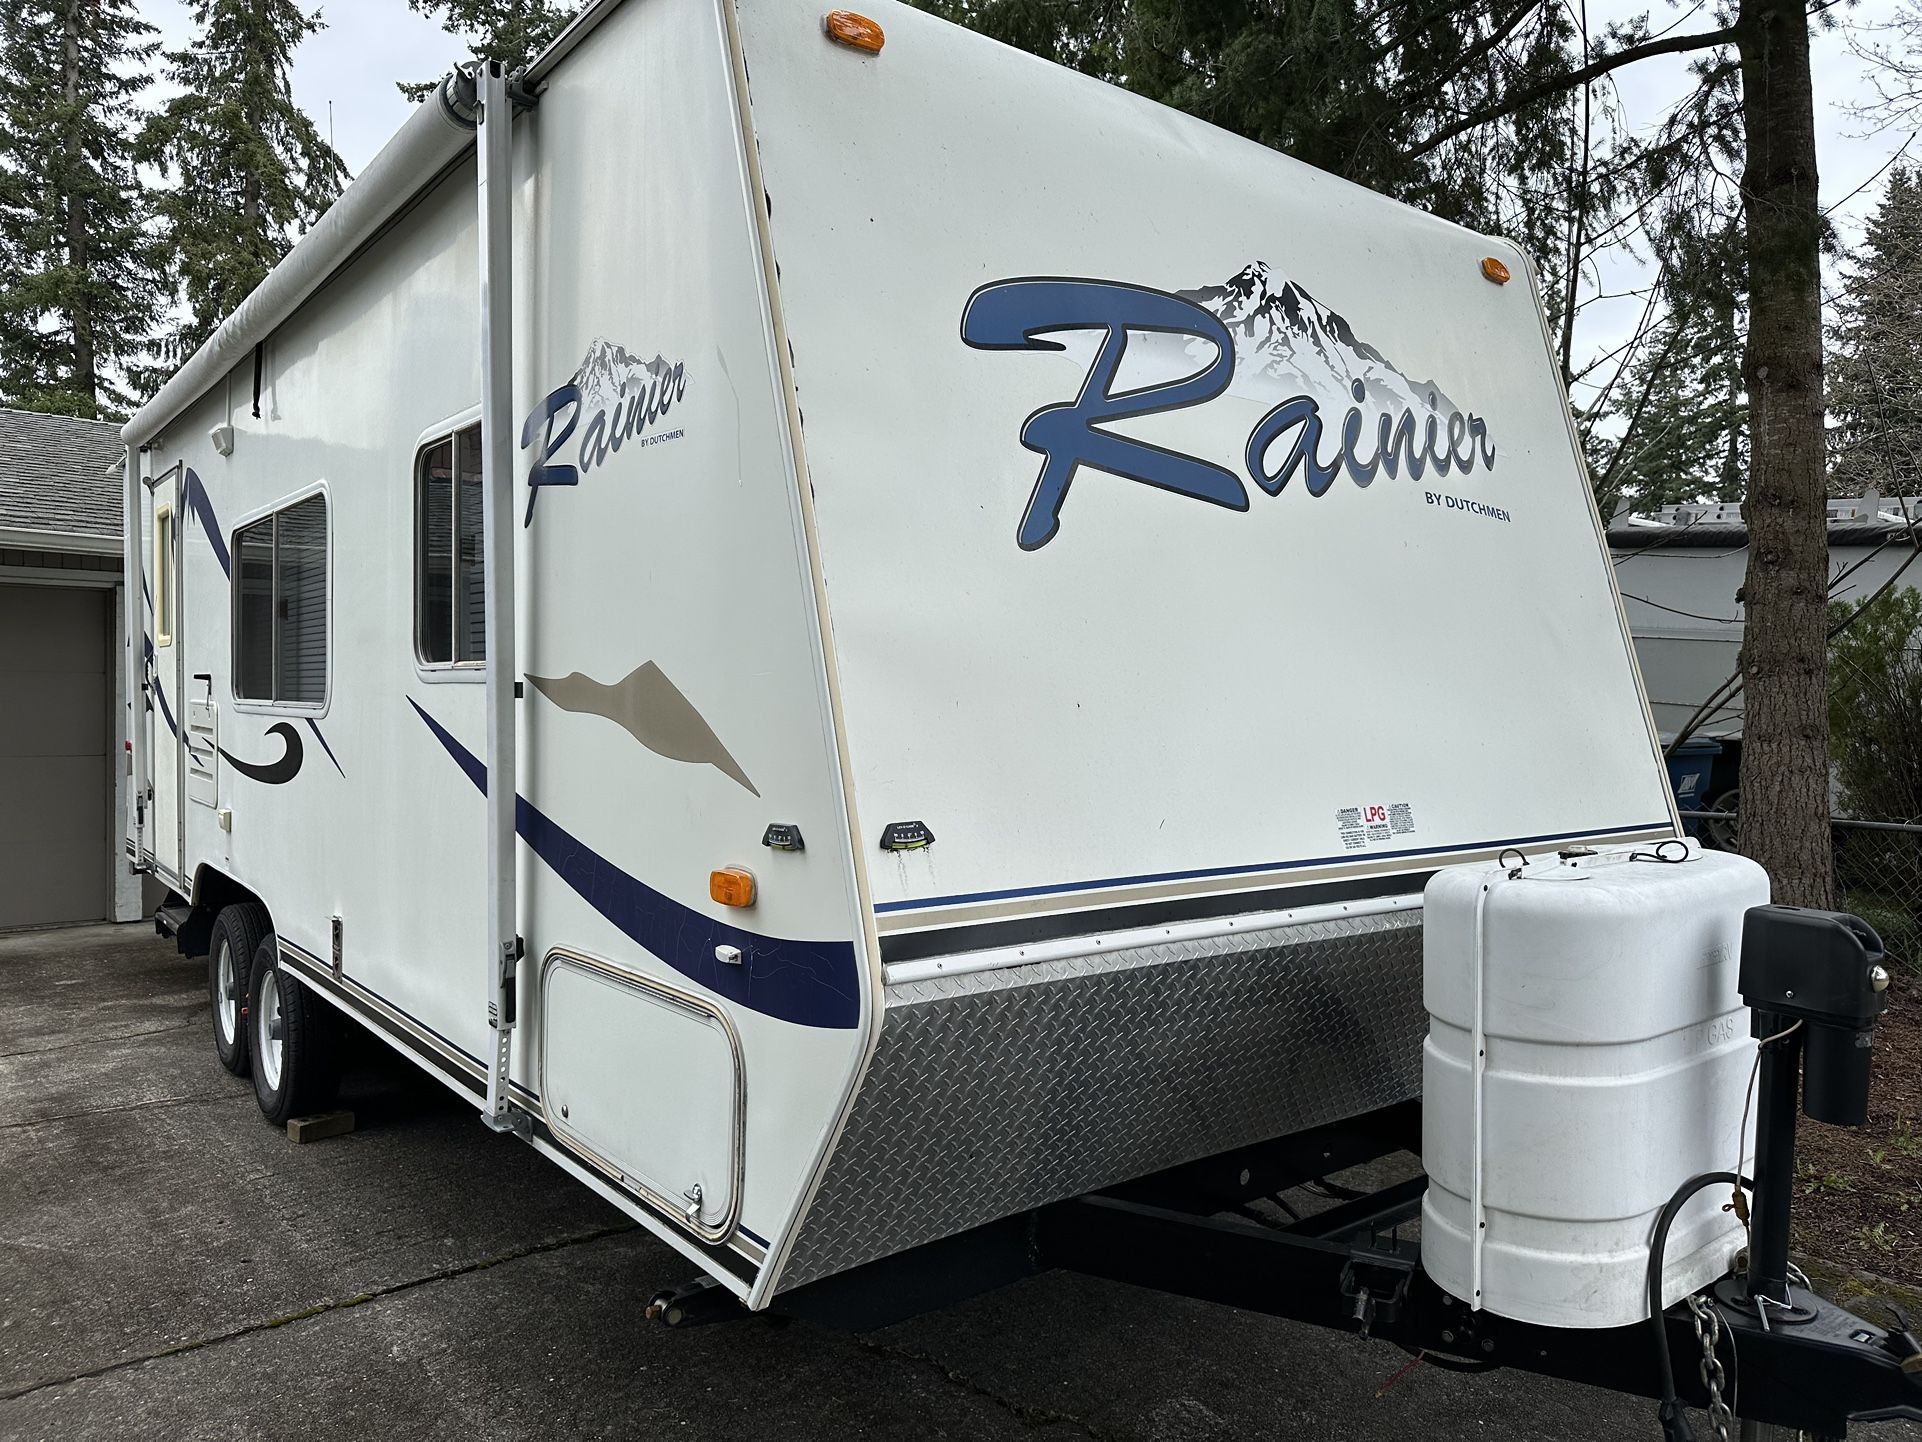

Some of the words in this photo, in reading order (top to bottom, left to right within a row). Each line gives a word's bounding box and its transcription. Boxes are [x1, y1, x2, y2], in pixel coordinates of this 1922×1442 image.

[961, 276, 1495, 551] Rainier
[521, 361, 686, 528] Rainier
[641, 438, 649, 448] BY
[650, 429, 684, 445] DUTCHMEN
[1424, 491, 1442, 506] BY
[1445, 495, 1511, 523] DUTCHMEN
[1363, 805, 1387, 823] LPG
[1707, 1017, 1734, 1046] GAS
